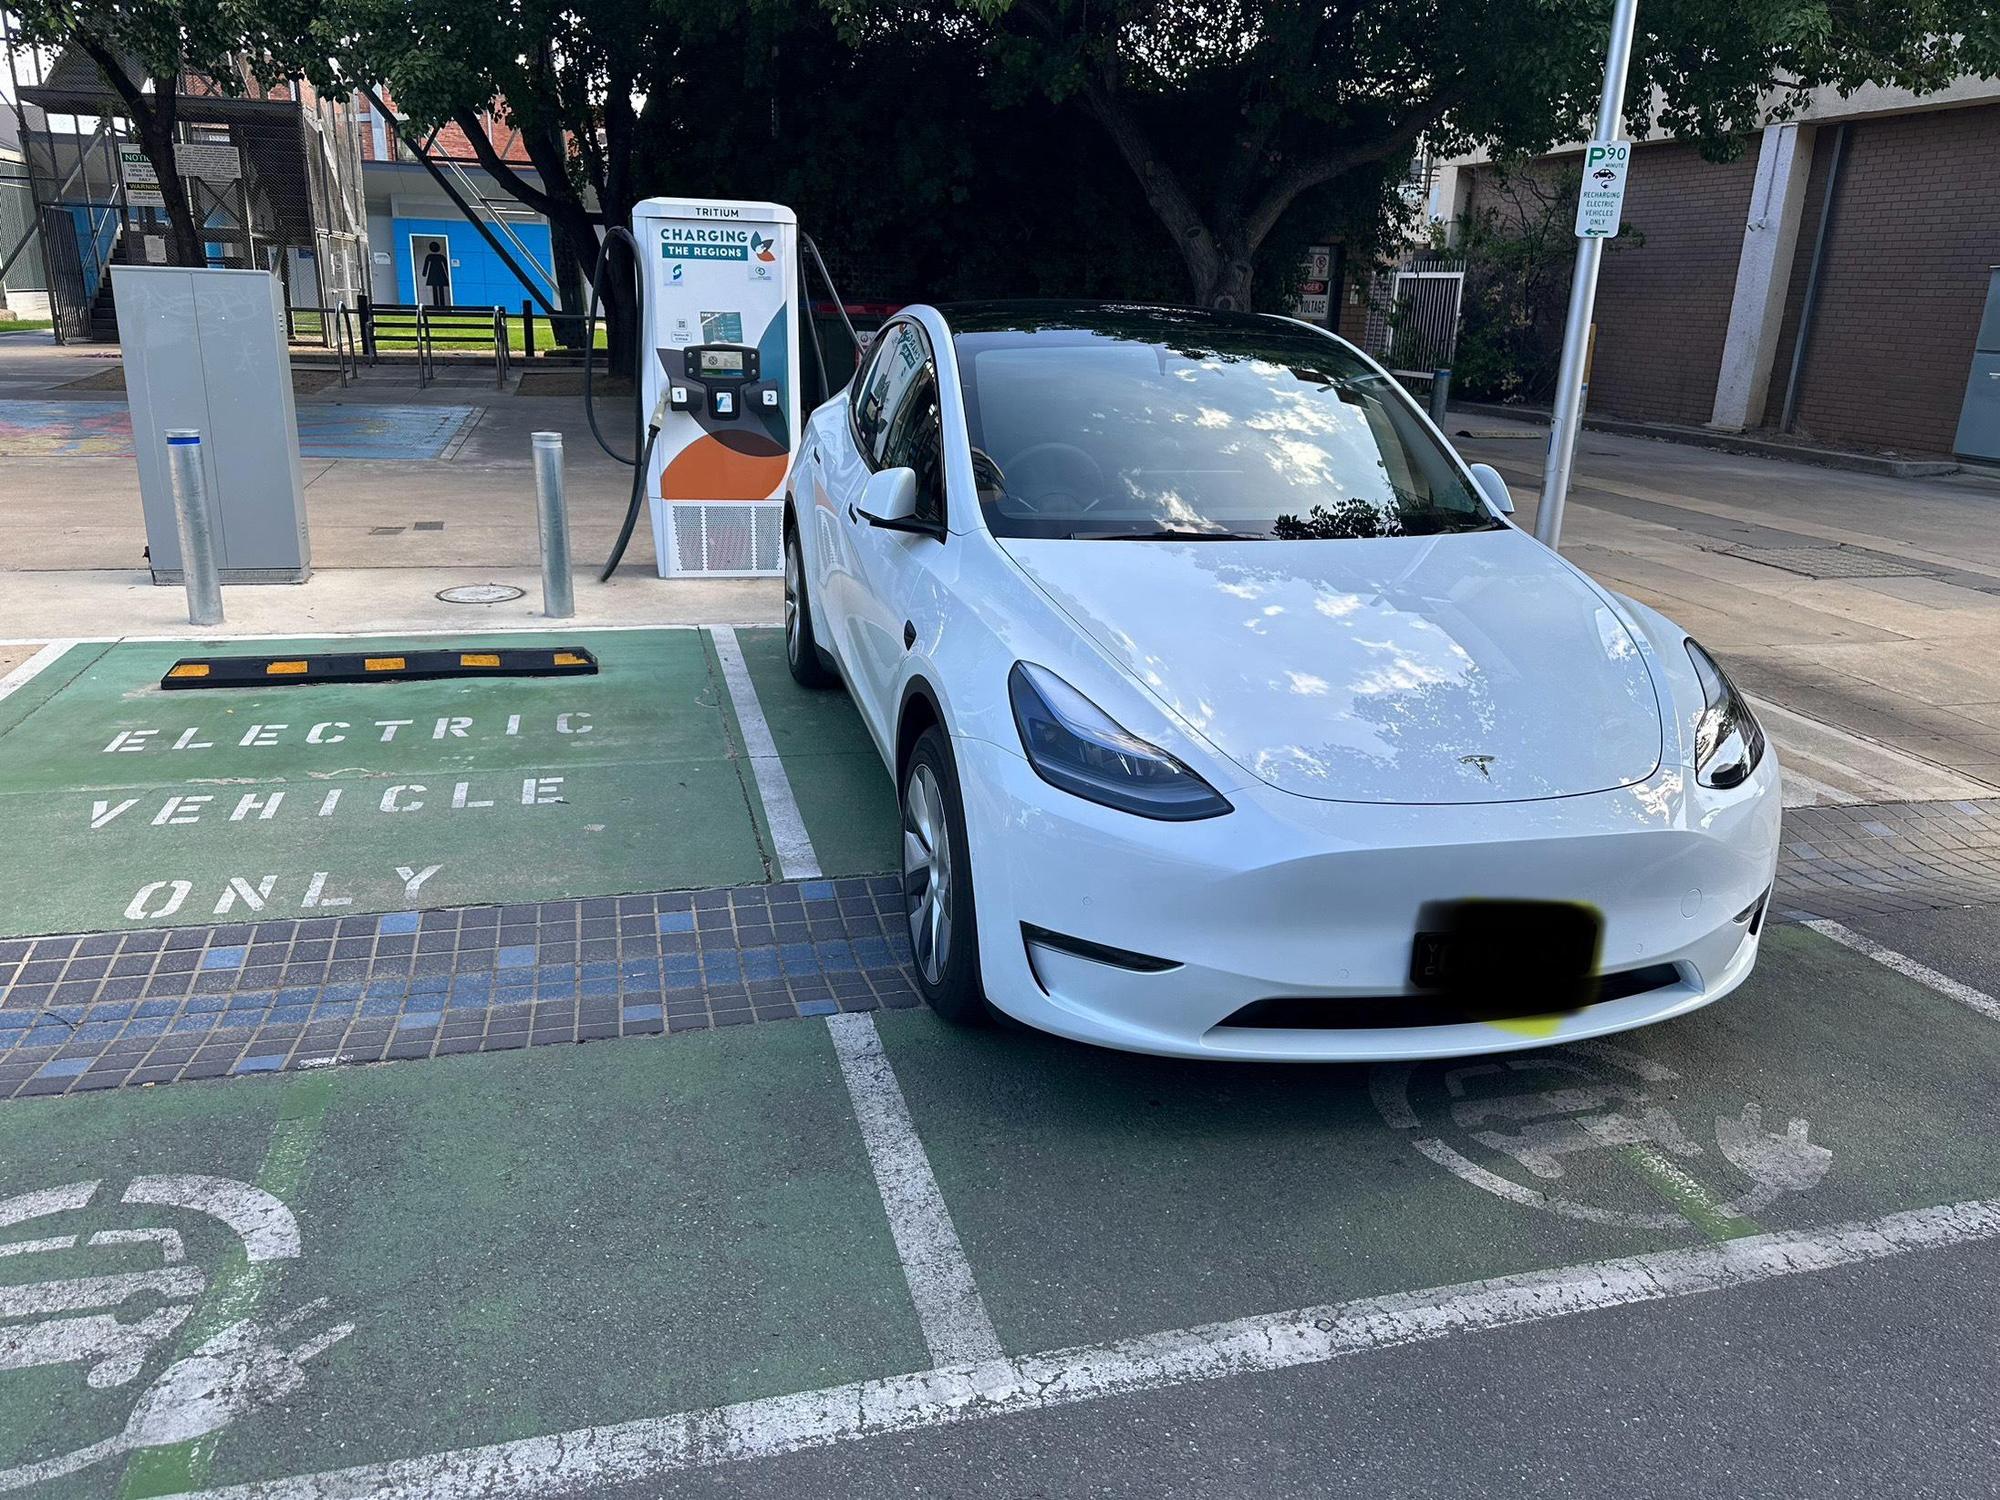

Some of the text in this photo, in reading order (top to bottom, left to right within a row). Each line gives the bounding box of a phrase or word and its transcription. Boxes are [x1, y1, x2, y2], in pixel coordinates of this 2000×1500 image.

[695, 208, 739, 217] TRITIUM
[660, 228, 748, 243] CHARGING
[668, 246, 742, 257] THE REGIONS
[677, 391, 683, 399] 1
[767, 393, 773, 402] 2
[103, 711, 593, 753] ELECTRIC
[90, 777, 565, 829] VEHICLE
[123, 864, 443, 920] ONLY
